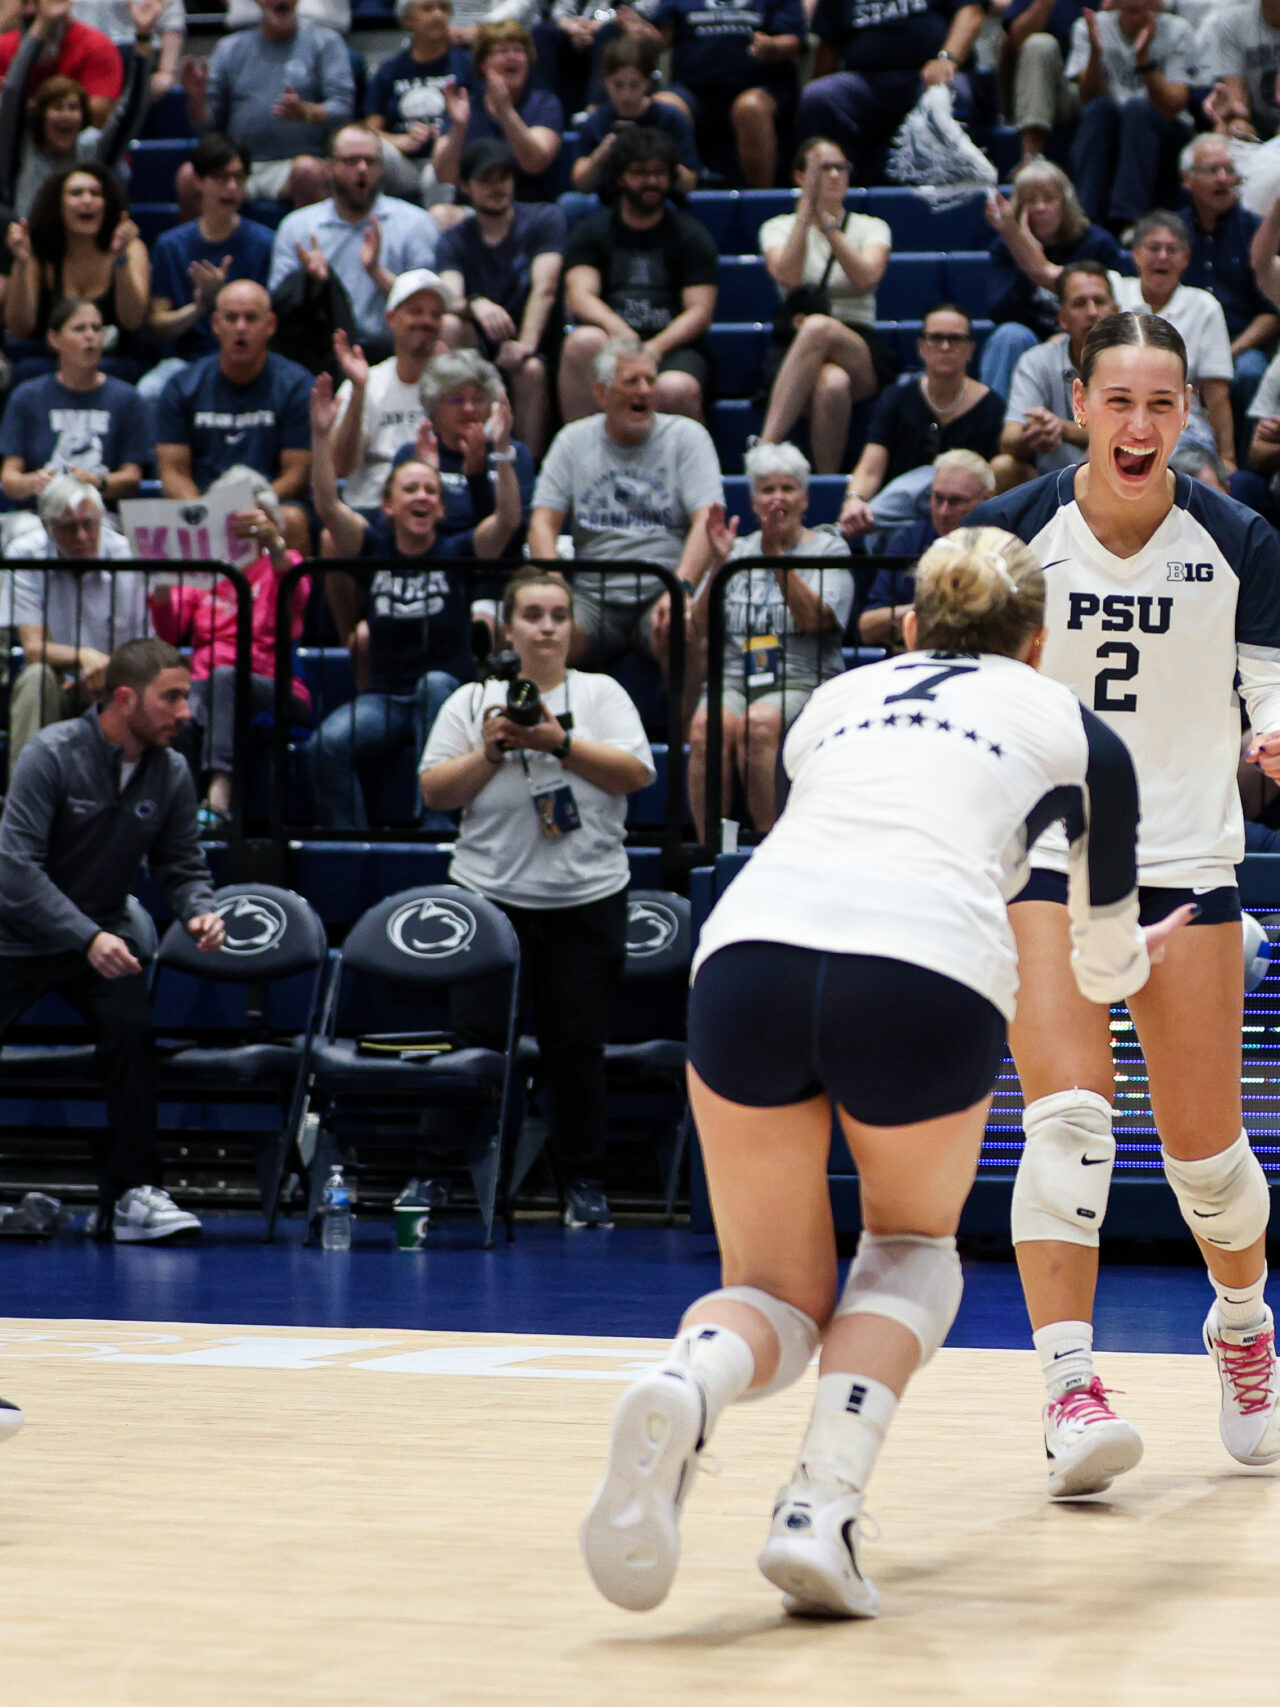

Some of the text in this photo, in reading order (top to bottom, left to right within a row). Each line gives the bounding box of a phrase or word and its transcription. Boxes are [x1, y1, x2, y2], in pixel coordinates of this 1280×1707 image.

[1067, 592, 1174, 634] PSU
[884, 664, 980, 704] 7
[1094, 641, 1140, 712] 2
